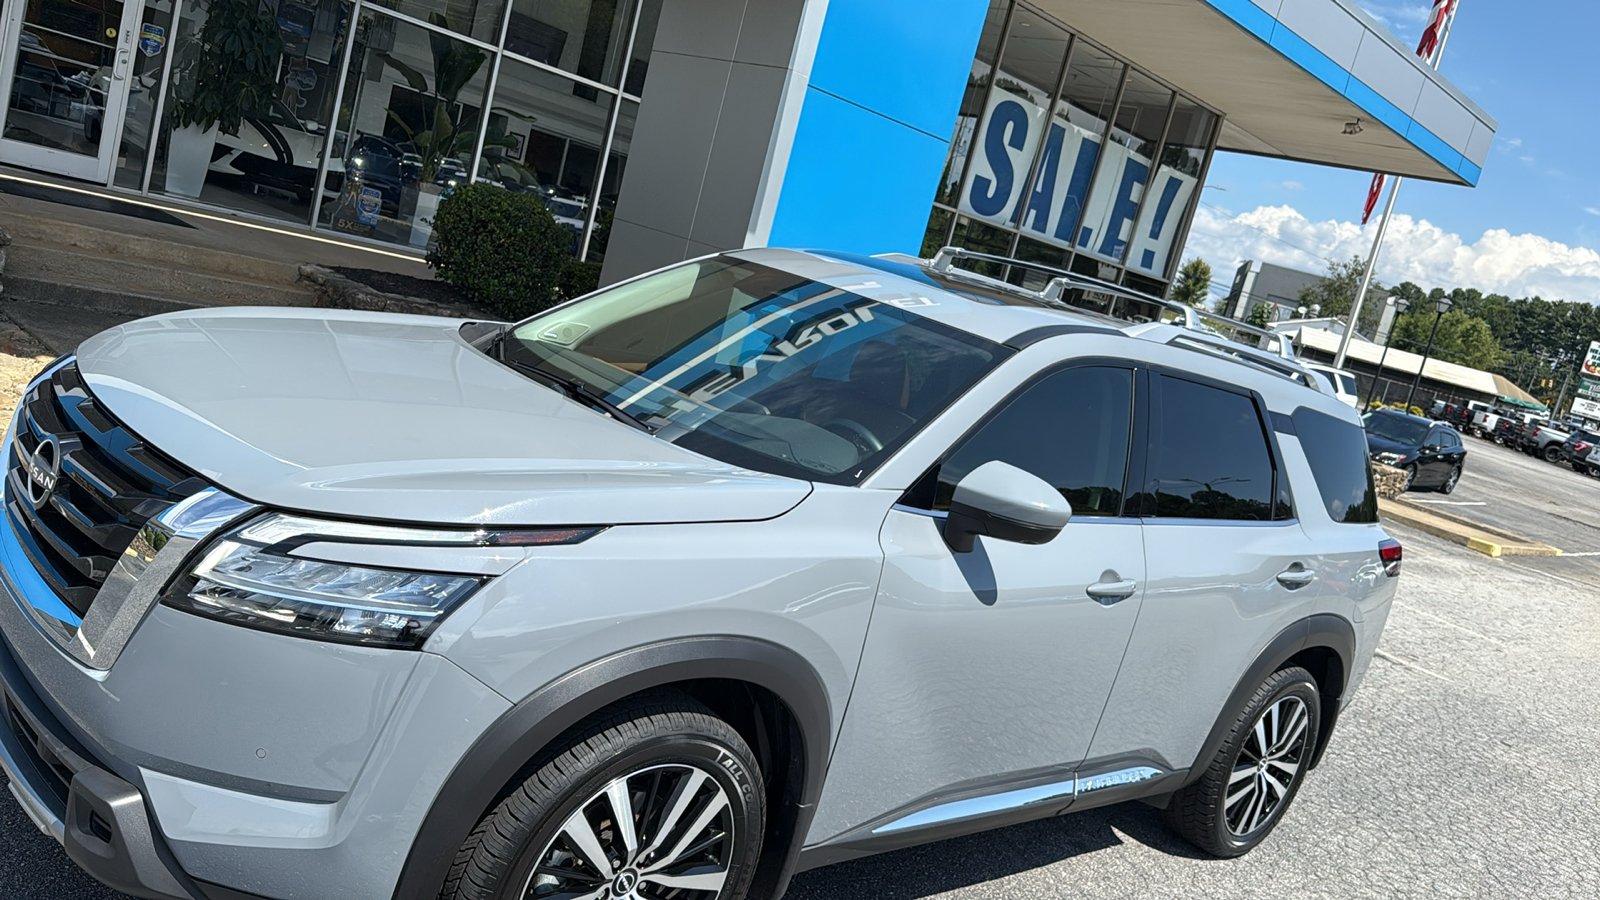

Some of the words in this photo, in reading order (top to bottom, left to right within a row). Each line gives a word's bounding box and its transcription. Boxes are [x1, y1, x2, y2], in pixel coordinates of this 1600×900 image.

[970, 100, 1183, 270] SALE!
[338, 219, 354, 230] 5X
[30, 462, 54, 489] SSAN
[722, 758, 743, 780] ALL
